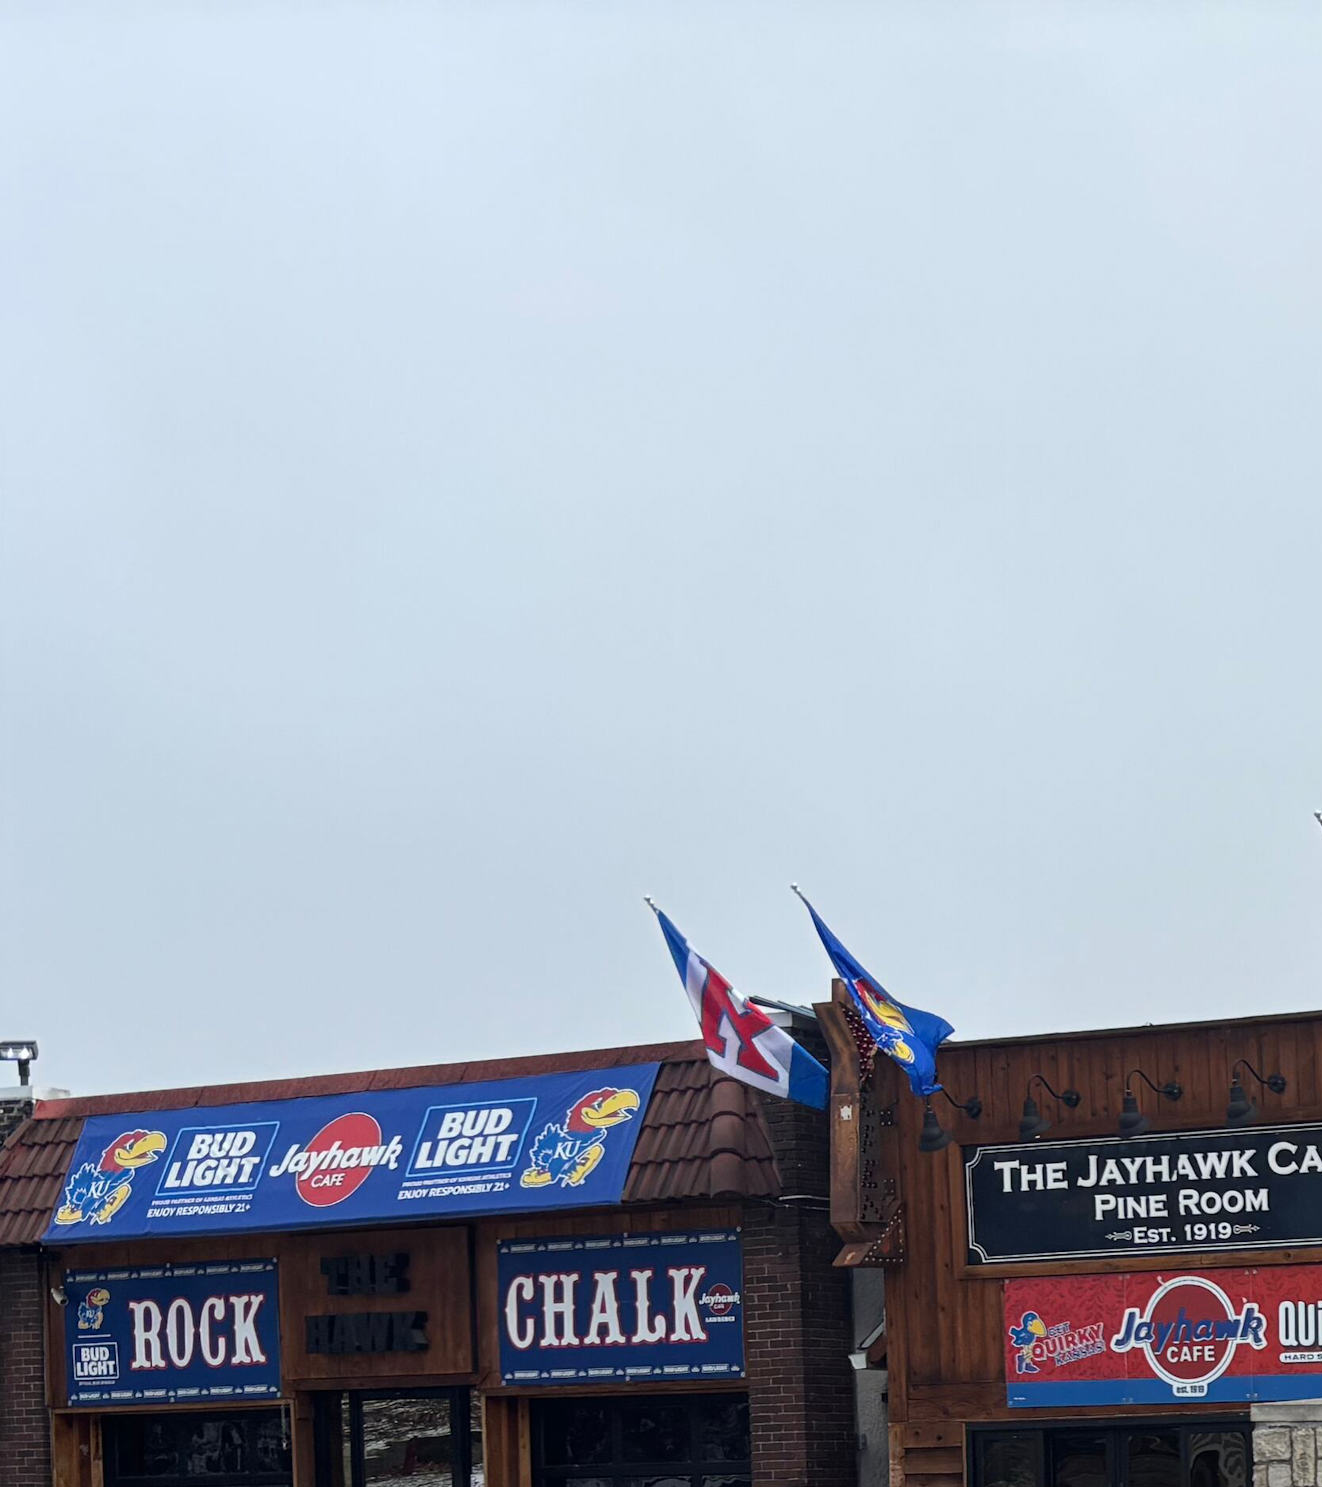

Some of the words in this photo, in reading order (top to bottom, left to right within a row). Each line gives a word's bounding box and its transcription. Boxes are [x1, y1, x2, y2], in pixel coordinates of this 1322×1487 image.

[437, 1108, 513, 1140] BUD
[186, 1131, 257, 1160] BUD
[269, 1135, 403, 1180] Jayhawk
[414, 1134, 519, 1169] LIGHT
[554, 1141, 581, 1160] KU
[164, 1157, 261, 1188] LIGHT
[311, 1173, 346, 1188] CAFE
[994, 1159, 1069, 1192] THE
[1077, 1149, 1258, 1187] JAYHAWK
[88, 1180, 110, 1198] KU
[397, 1189, 429, 1200] ENJOY
[429, 1183, 493, 1197] RESPONSIBLY
[493, 1182, 510, 1191] 21+
[147, 1208, 176, 1218] ENJOY
[176, 1204, 235, 1216] RESPONSIBLY
[235, 1202, 251, 1212] 21+
[1094, 1194, 1169, 1220] PINE
[1178, 1188, 1270, 1216] ROOM
[1133, 1225, 1176, 1243] EST.
[1185, 1222, 1232, 1241] 1919
[505, 1266, 708, 1349] CHALK
[699, 1292, 740, 1306] Jayhawk
[129, 1294, 267, 1369] ROCK
[1031, 1322, 1104, 1361] QUIRKY
[1110, 1303, 1267, 1356] Jayhawk
[80, 1347, 110, 1361] BUD
[1167, 1345, 1216, 1363] CAFE
[1284, 1353, 1314, 1361] HARD
[76, 1360, 116, 1376] LIGHT
